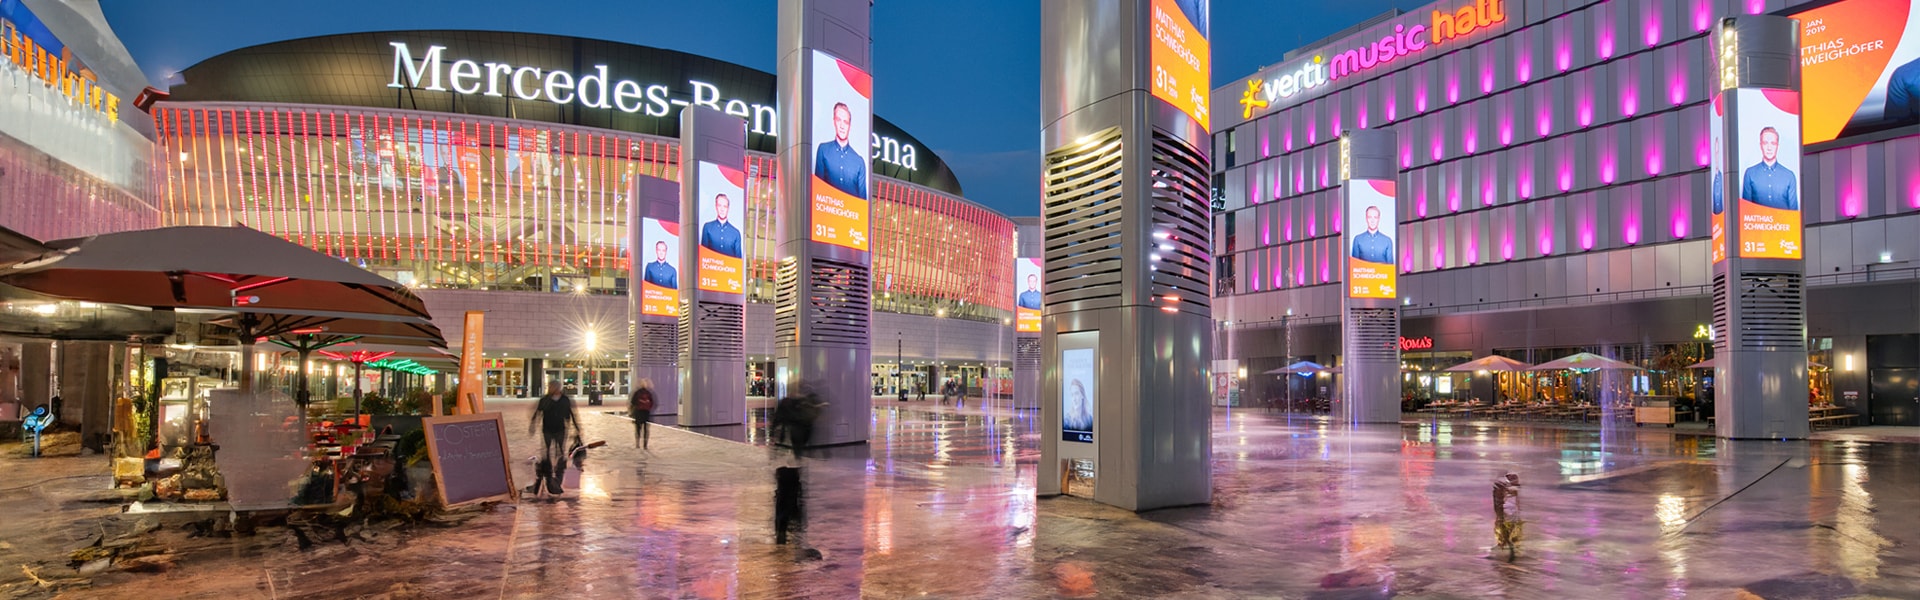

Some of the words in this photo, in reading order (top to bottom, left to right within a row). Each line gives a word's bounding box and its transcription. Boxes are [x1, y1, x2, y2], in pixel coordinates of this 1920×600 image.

[1155, 5, 1186, 43] MATTHIAS
[1805, 25, 1826, 36] 2019
[1806, 18, 1823, 29] JAN
[1155, 23, 1200, 73] SCHWEIGHÖFER
[1264, 55, 1325, 102] verti
[1329, 24, 1426, 81] music
[1432, 0, 1506, 44] hall
[1801, 38, 1845, 56] TTHIAS
[1156, 65, 1168, 92] 31
[387, 41, 777, 137] Mercedes-Ben
[872, 132, 918, 172] ena
[815, 194, 844, 208] MATTHIAS
[815, 202, 859, 220] SCHWEIGHÖFER
[1743, 214, 1774, 223] MATTHIAS
[815, 223, 827, 237] 31
[1743, 222, 1791, 231] SCHWEIGHÖFER
[1744, 241, 1756, 252] 31
[701, 277, 711, 286] 31
[1353, 285, 1362, 294] 31
[1398, 336, 1432, 351] ROMA'S
